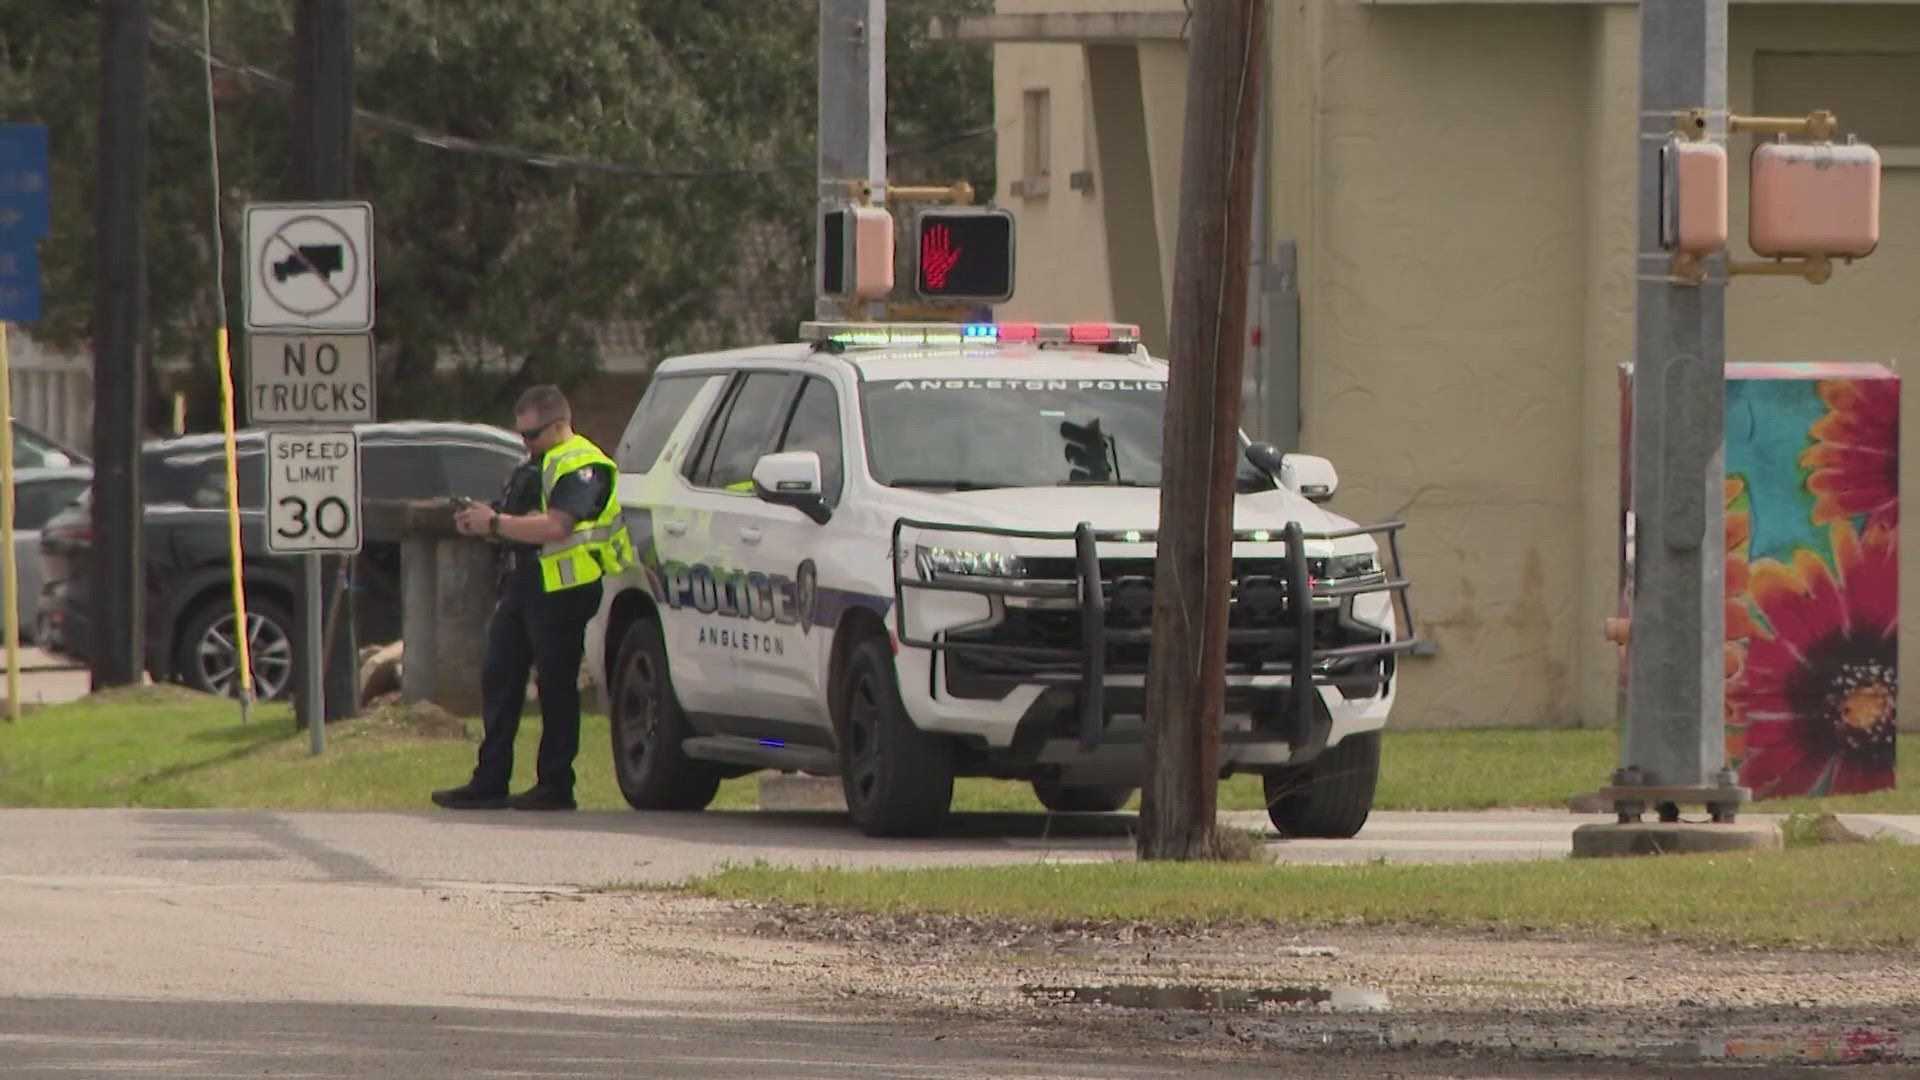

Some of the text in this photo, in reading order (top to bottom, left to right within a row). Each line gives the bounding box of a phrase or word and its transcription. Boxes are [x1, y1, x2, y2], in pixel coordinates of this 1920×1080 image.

[284, 343, 339, 376] NO
[255, 382, 367, 412] TRUCKS
[895, 379, 1169, 391] ANGLETON POLIC
[277, 442, 348, 460] SPEED
[286, 466, 338, 483] LIMIT
[277, 496, 350, 538] 30
[664, 560, 798, 625] POLICE
[699, 626, 784, 655] ANGLETON
